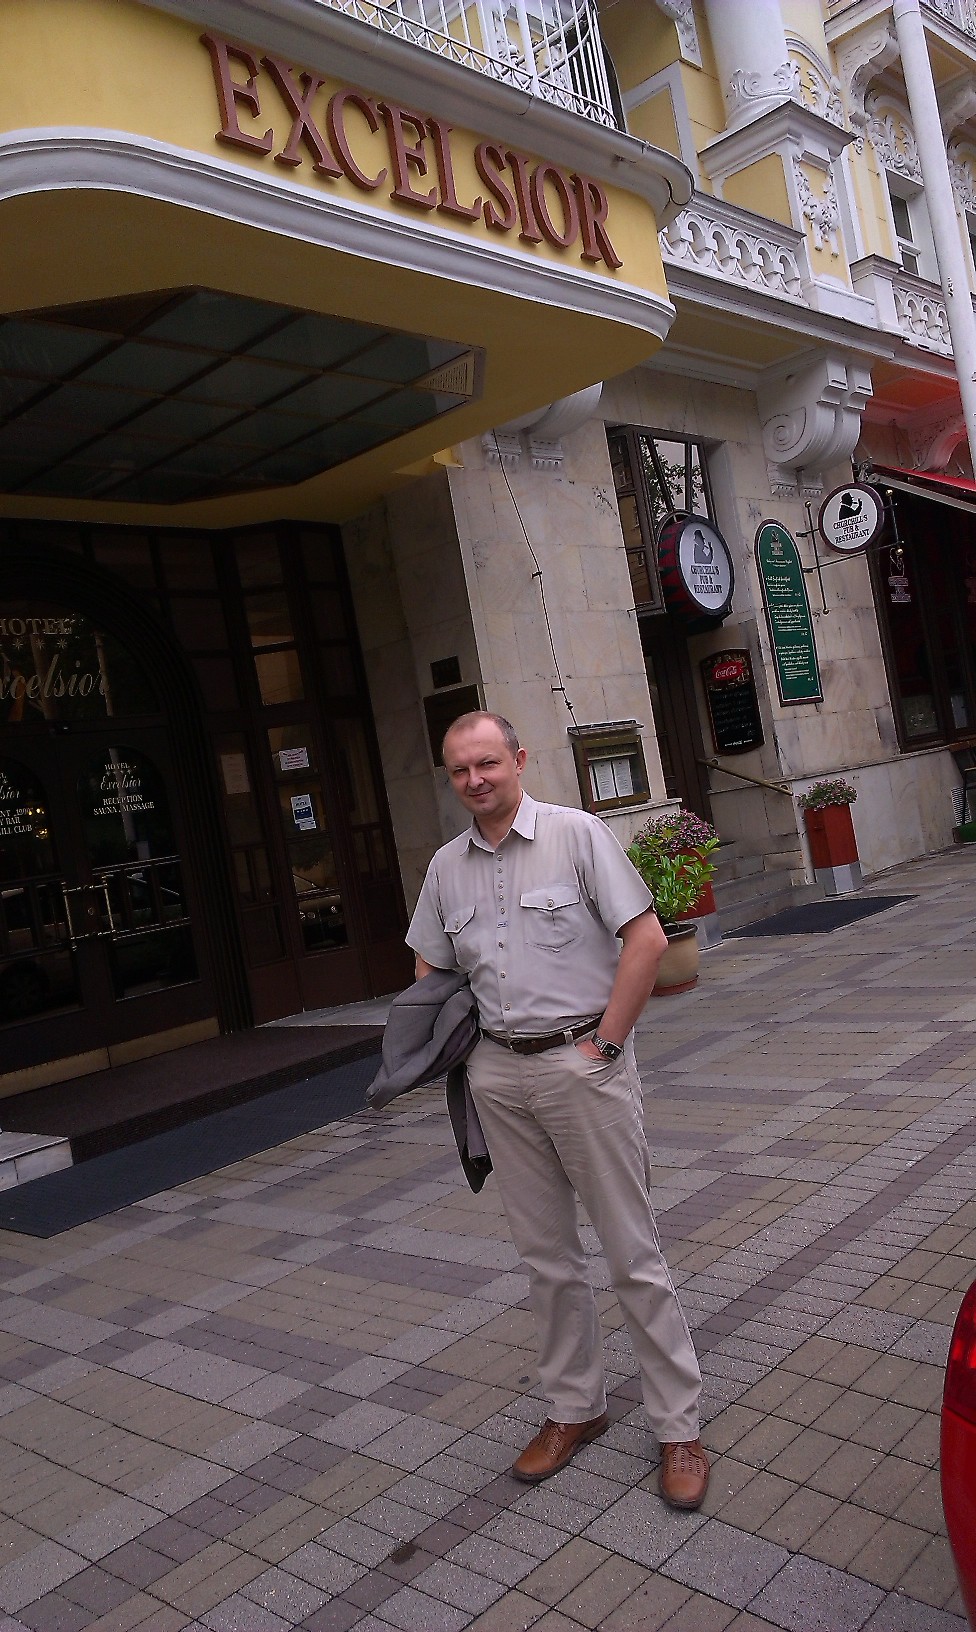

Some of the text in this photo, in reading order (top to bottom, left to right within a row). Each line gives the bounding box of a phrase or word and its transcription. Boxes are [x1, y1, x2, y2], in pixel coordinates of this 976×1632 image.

[201, 33, 623, 270] EXCELSIOR
[835, 528, 870, 544] RESTAURANT
[843, 525, 854, 535] PUB
[104, 762, 130, 771] HOTEL
[99, 773, 141, 791] Excelsior
[103, 794, 143, 806] RECEPTION
[13, 823, 33, 834] CLUB
